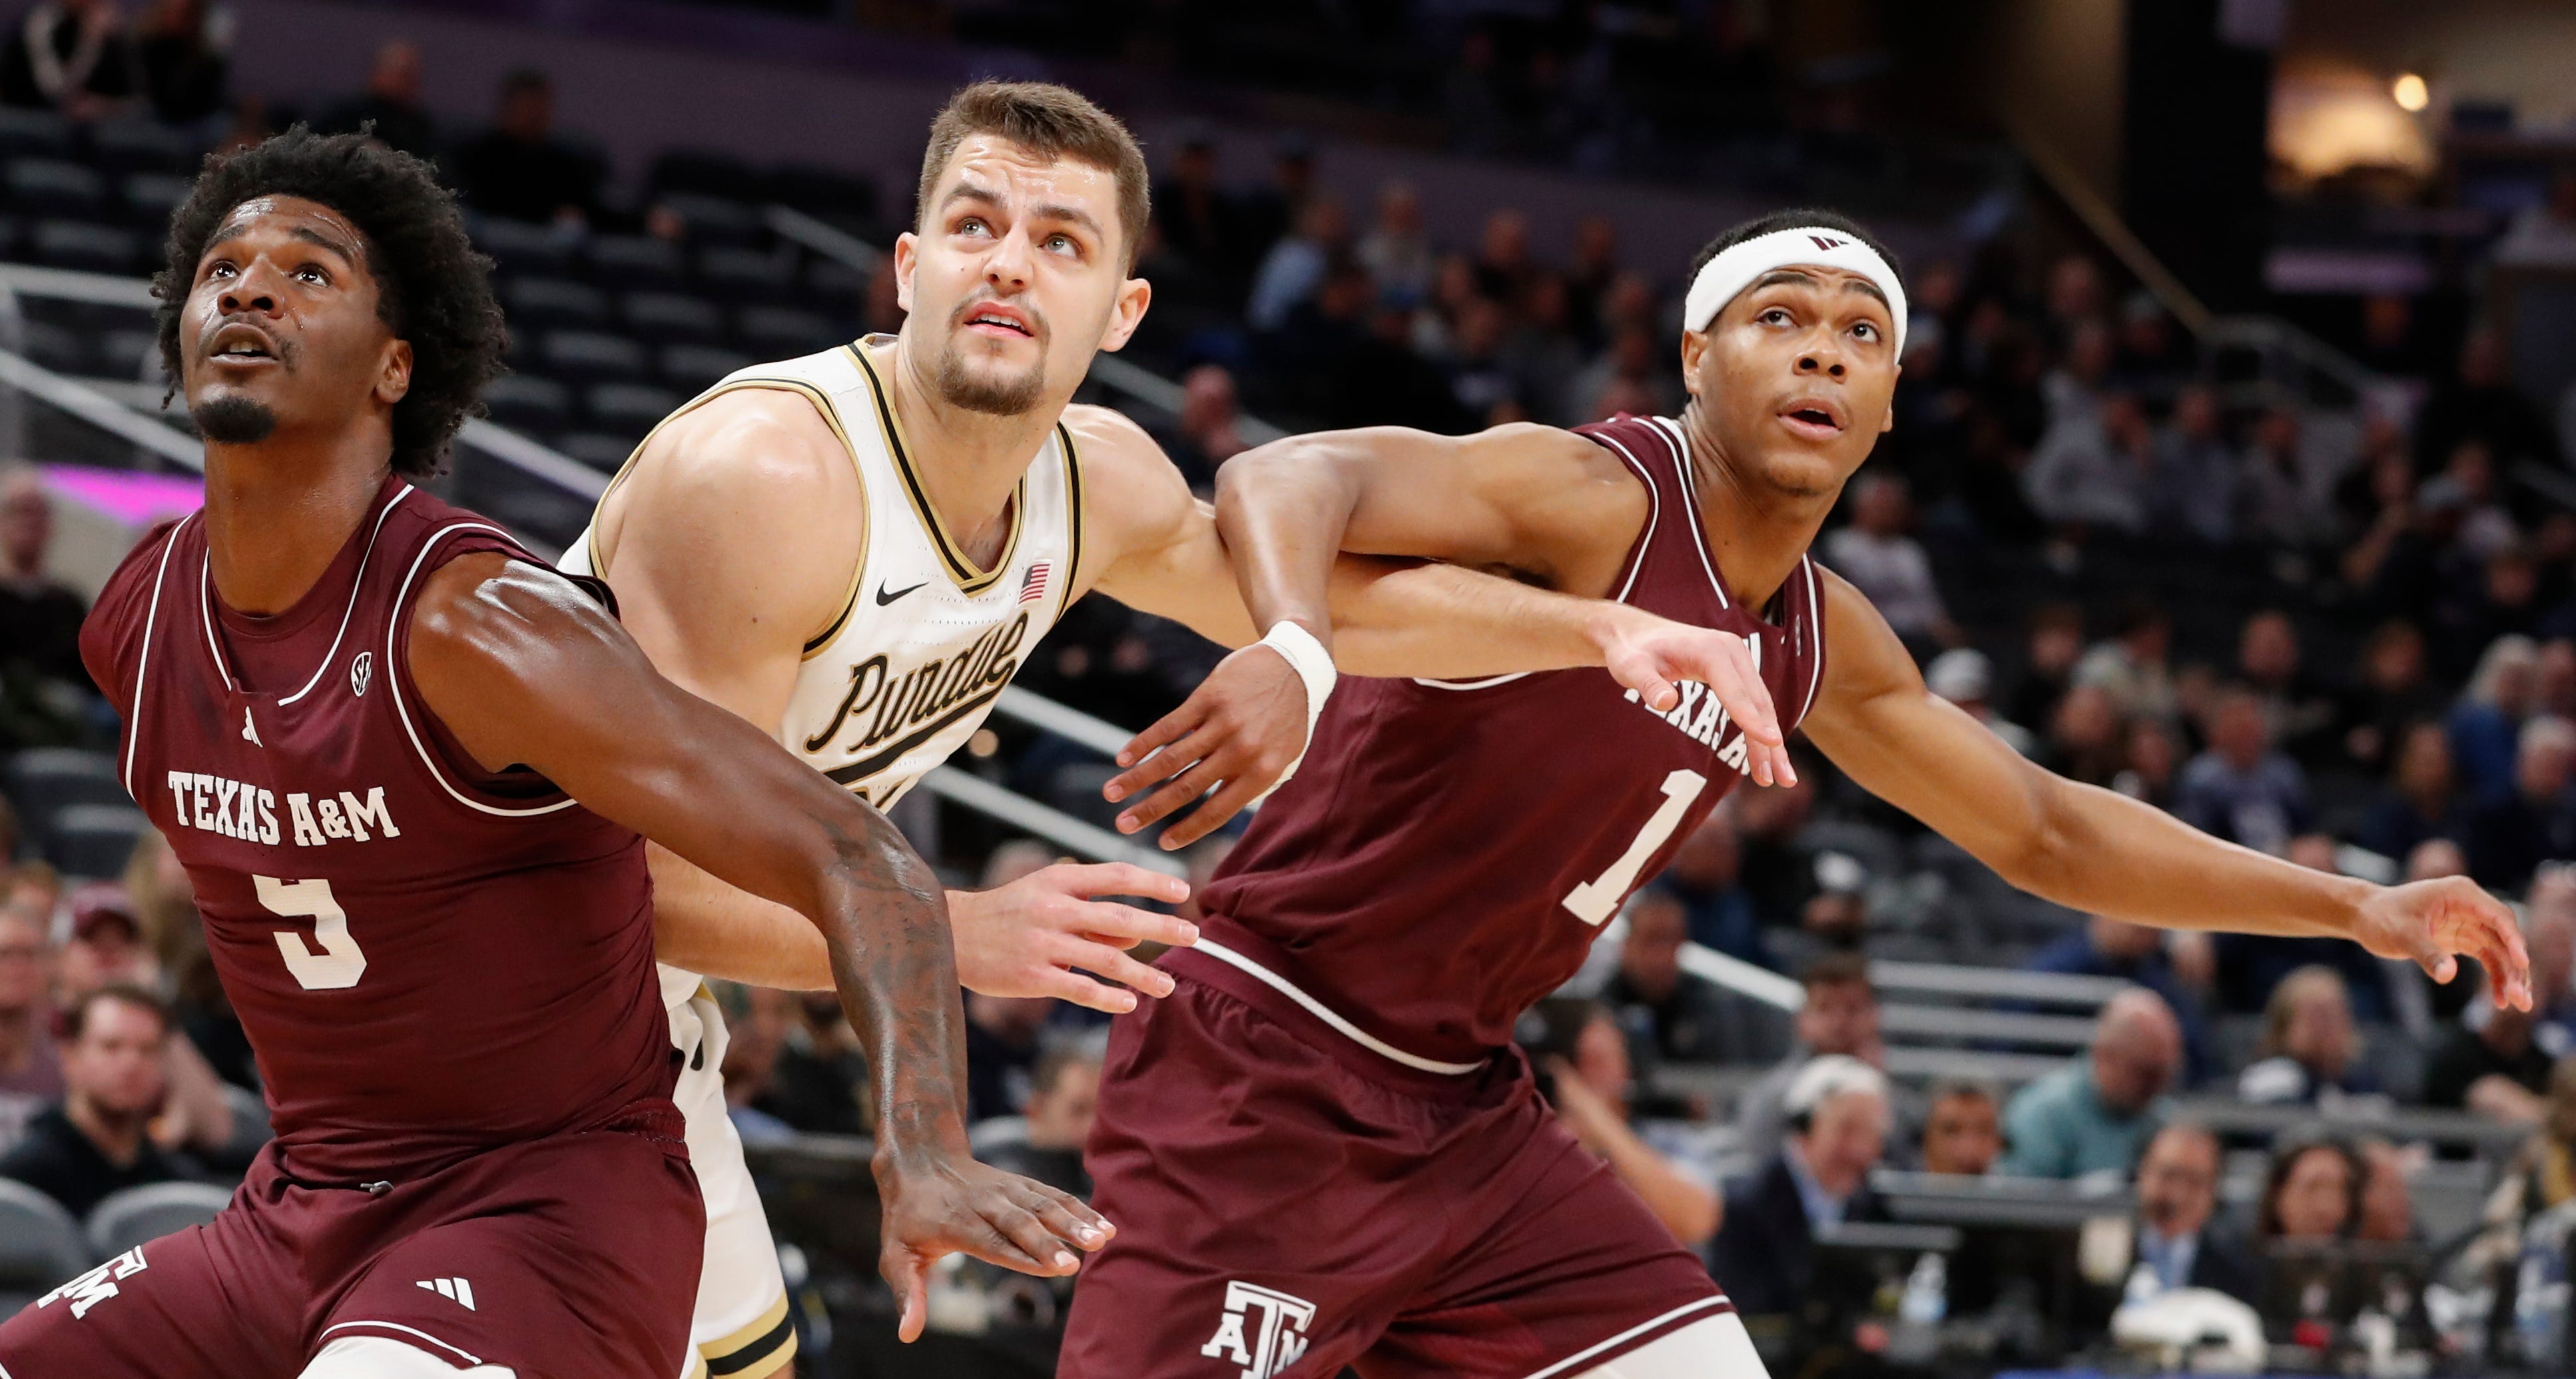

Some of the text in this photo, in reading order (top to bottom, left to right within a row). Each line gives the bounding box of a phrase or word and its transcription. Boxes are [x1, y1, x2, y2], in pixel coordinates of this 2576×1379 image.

[805, 610, 1028, 753] Purdue
[168, 771, 400, 846] TEXAS A&M
[1562, 769, 1707, 926] 1
